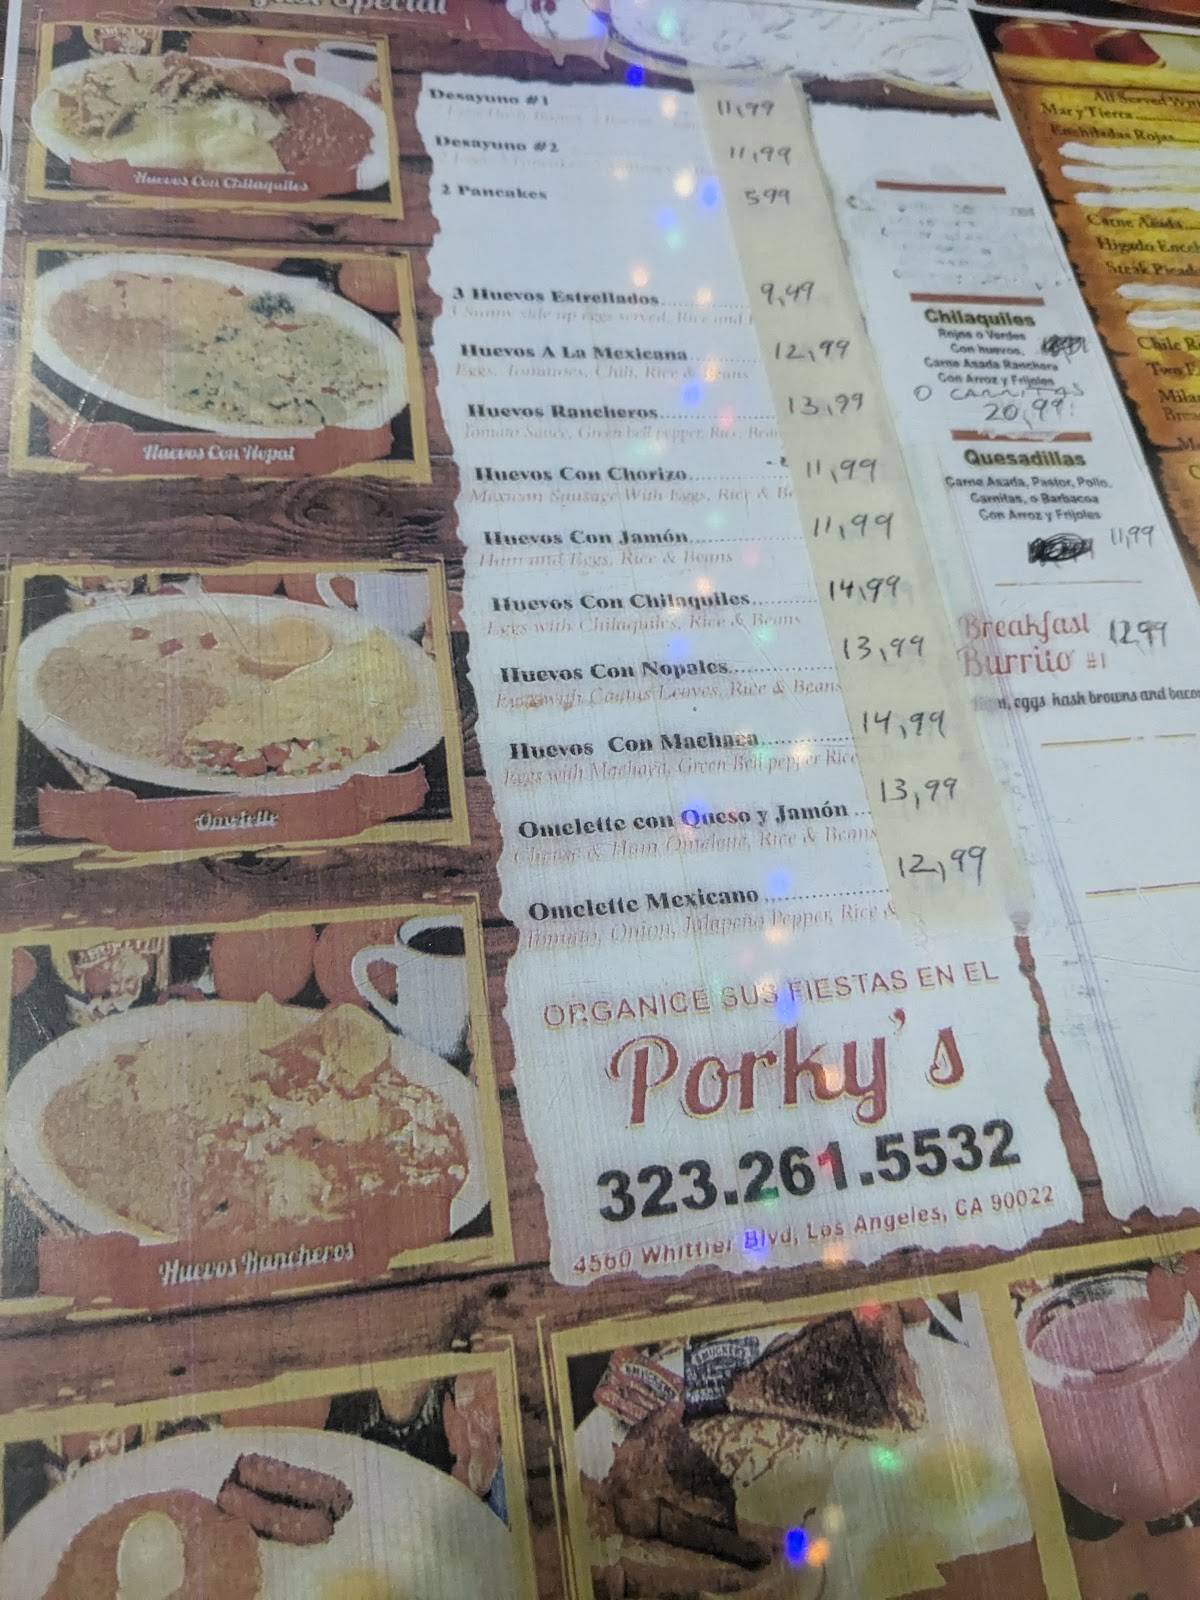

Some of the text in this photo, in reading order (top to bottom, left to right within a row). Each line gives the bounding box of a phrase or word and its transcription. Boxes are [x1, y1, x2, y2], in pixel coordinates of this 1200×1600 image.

[430, 88, 549, 106] Desayuno #1
[435, 135, 559, 153] Desayuno #2
[1133, 129, 1175, 144] Rojas
[441, 185, 548, 200] 2 Pancakes
[453, 287, 659, 305] 3 Huevos Estrellados
[924, 308, 1036, 328] Chilaquiles
[986, 329, 1026, 341] Verdes
[461, 344, 687, 361] Huevos A La Mexicana
[950, 343, 975, 354] Con
[924, 357, 1001, 370] Carne Asada
[938, 372, 963, 384] Con
[965, 373, 998, 385] Arroz
[468, 404, 658, 419] Huevos Rancheros
[964, 448, 1087, 466] Quesadillas
[475, 466, 687, 481] Huevos Con Chorizo
[945, 476, 983, 488] Carne
[1041, 492, 1100, 504] Barbacoa
[979, 508, 1005, 521] Con
[1008, 509, 1043, 521] Arroz
[1055, 509, 1102, 522] Frijoles
[484, 528, 688, 546] Huevos Con Jamón
[492, 591, 750, 612] Huevos Con Chilaquiles
[958, 611, 1090, 643] Breakfast
[957, 646, 1074, 677] Burrito
[500, 660, 729, 683] Huevos Con Nopales
[1013, 696, 1046, 713] eggs
[1052, 691, 1086, 708] hash
[1088, 689, 1136, 705] browns
[1140, 687, 1166, 701] and
[510, 742, 594, 760] Huevos
[607, 736, 652, 753] Con
[518, 800, 850, 839] Omelette con Queso y Jamón
[529, 888, 759, 921] Omelette Mexicano
[543, 960, 1000, 1029] ORGANICE SUS FIESTAS EN EL
[606, 1007, 967, 1127] Porky's
[597, 1118, 1021, 1222] 323.261.5532
[573, 1250, 632, 1276] 4560
[641, 1240, 734, 1266] Whittier
[806, 1221, 847, 1243] Los
[853, 1206, 949, 1235] Angeles,
[955, 1200, 983, 1218] CA
[991, 1184, 1054, 1210] 90022
[241, 1241, 355, 1276] Rancheros
